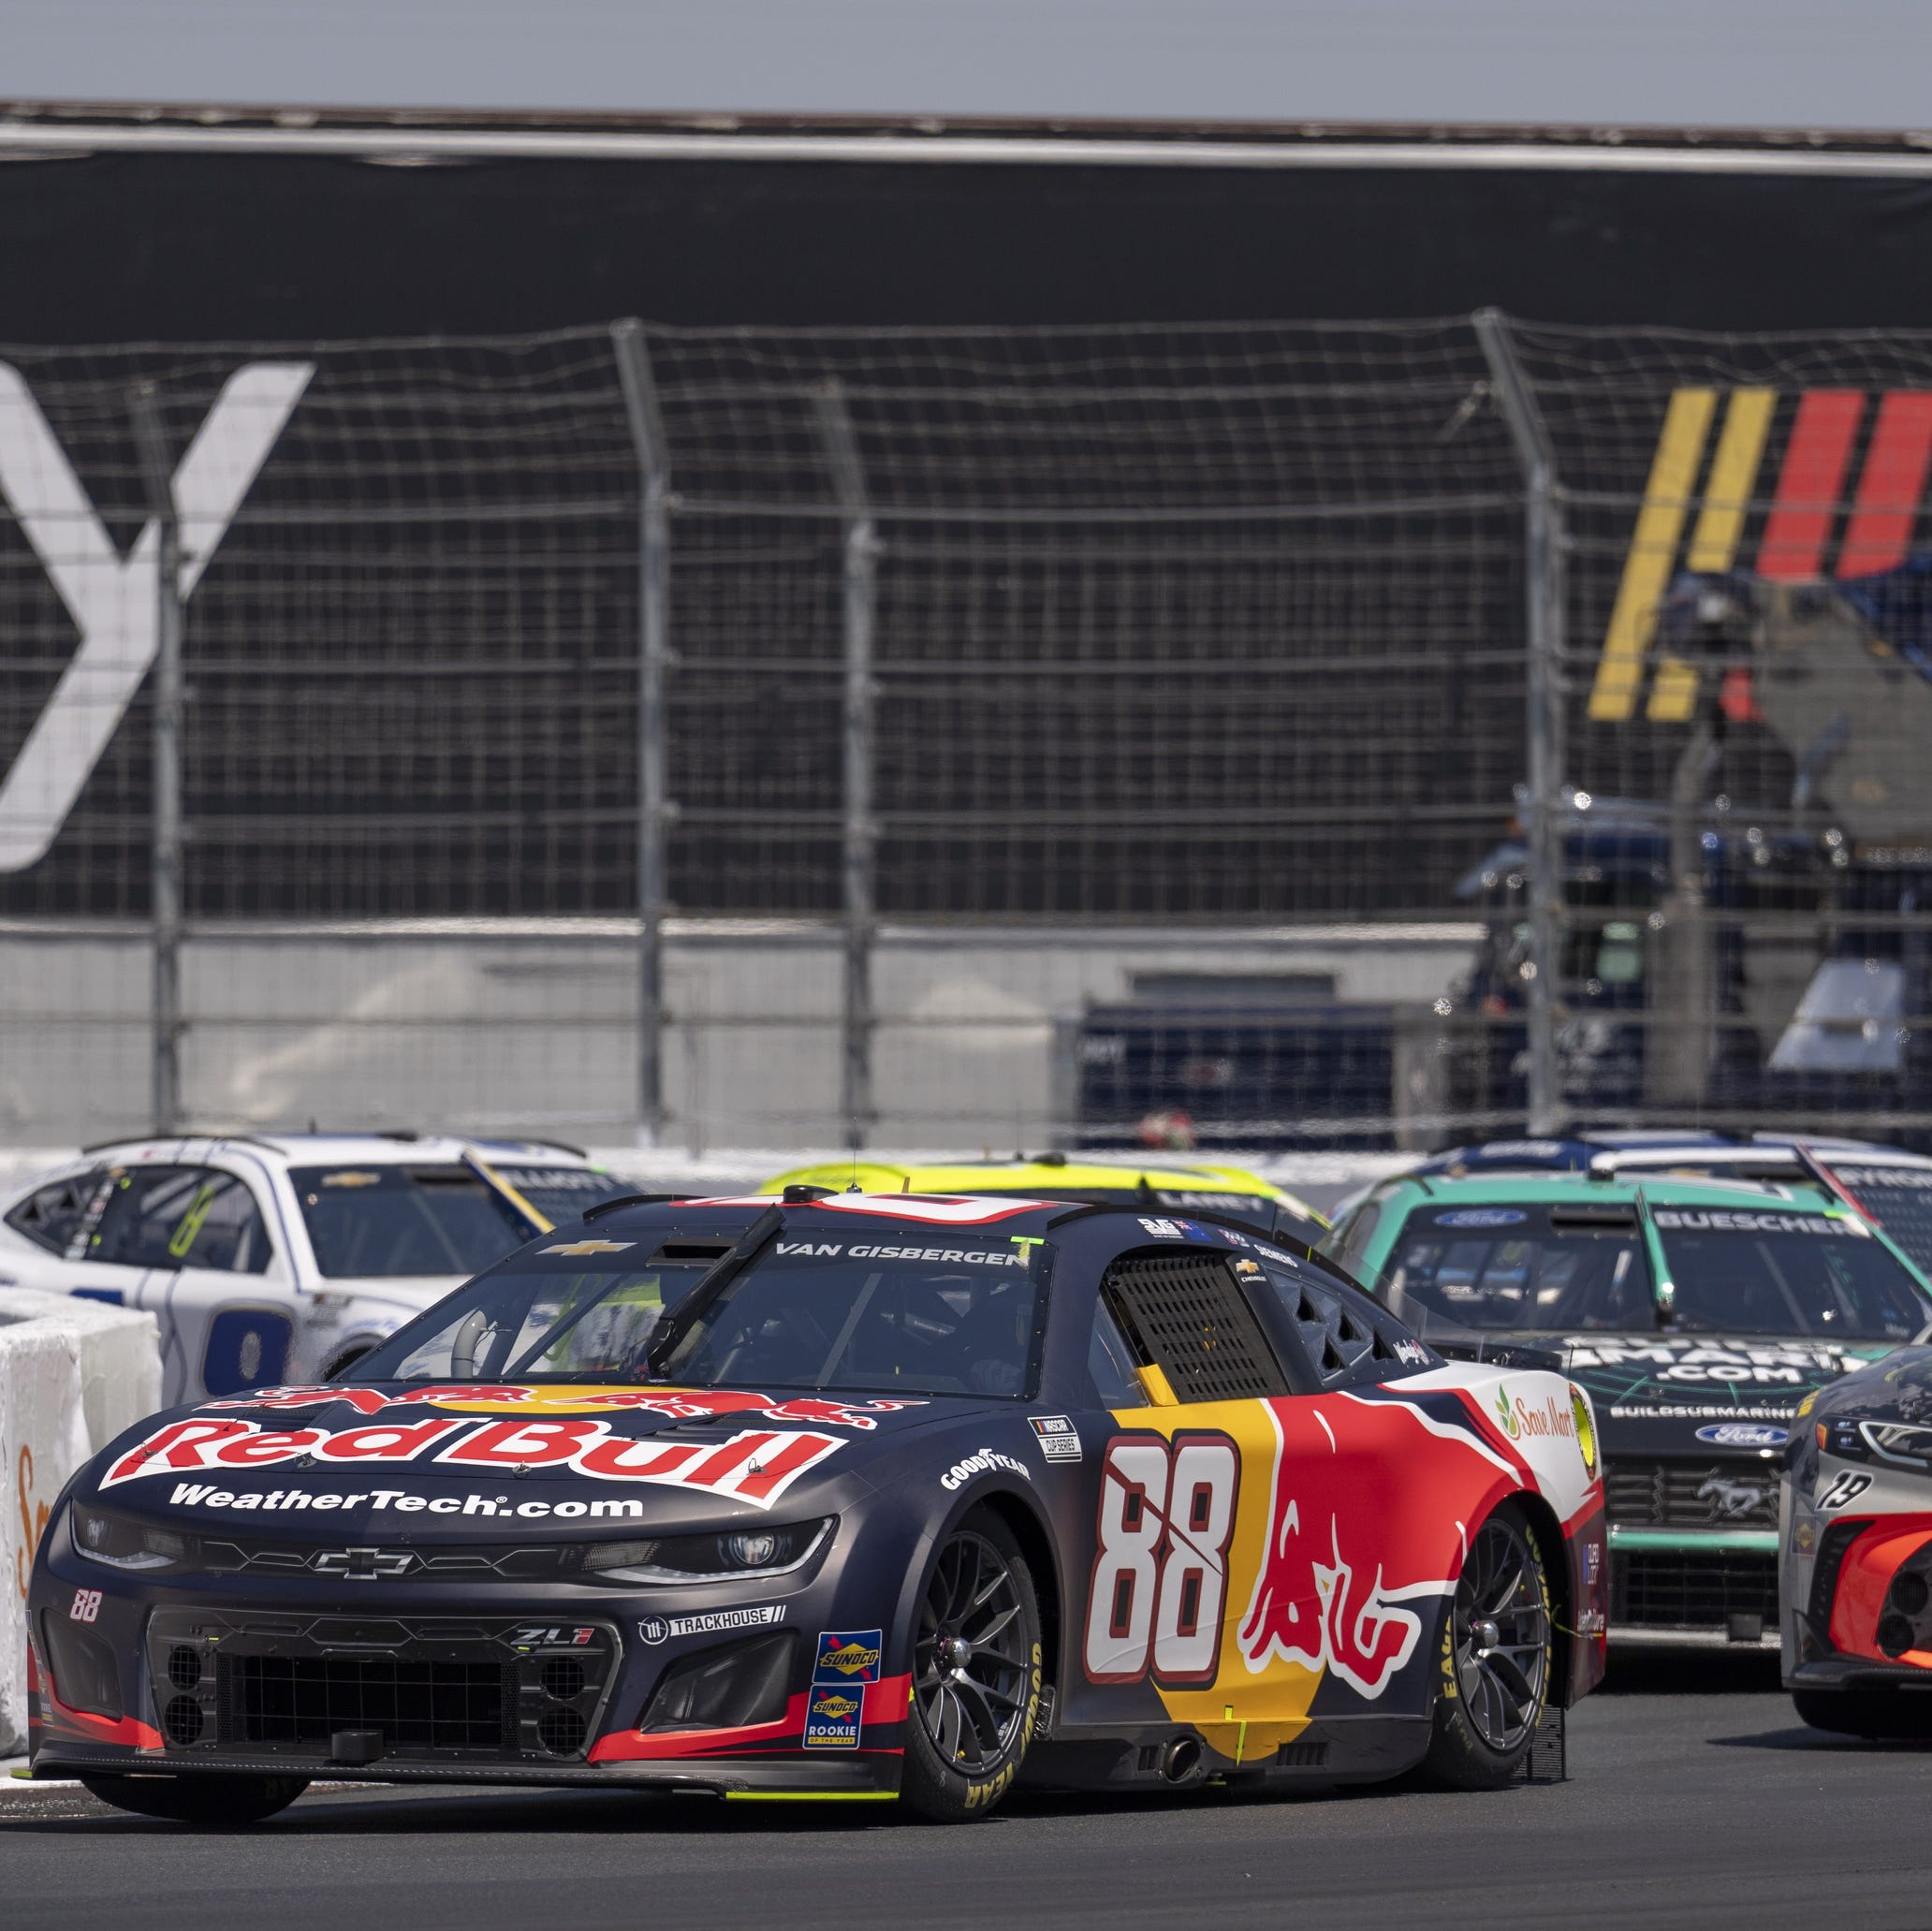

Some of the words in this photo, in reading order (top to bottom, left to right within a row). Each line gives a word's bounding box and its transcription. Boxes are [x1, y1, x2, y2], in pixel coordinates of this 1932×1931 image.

[776, 1243, 842, 1256] VAN
[848, 1245, 1030, 1266] GISBERGEN
[1515, 1397, 1550, 1437] Save
[1547, 1396, 1575, 1438] Mart
[1046, 1440, 1057, 1453] CUP
[1057, 1439, 1076, 1452] SERIES
[97, 1418, 476, 1491] Red
[434, 1419, 849, 1511] Bull
[940, 1448, 1032, 1490] GOODYEAR
[1815, 1470, 1874, 1511] 19
[1084, 1435, 1239, 1685] 88
[70, 1588, 103, 1623] 88
[675, 1608, 768, 1634] TRACKHOUSE
[510, 1628, 595, 1646] ZL1
[821, 1650, 876, 1667] SUNOCO
[815, 1702, 856, 1713] SUNOCO
[808, 1726, 856, 1736] ROOKIE
